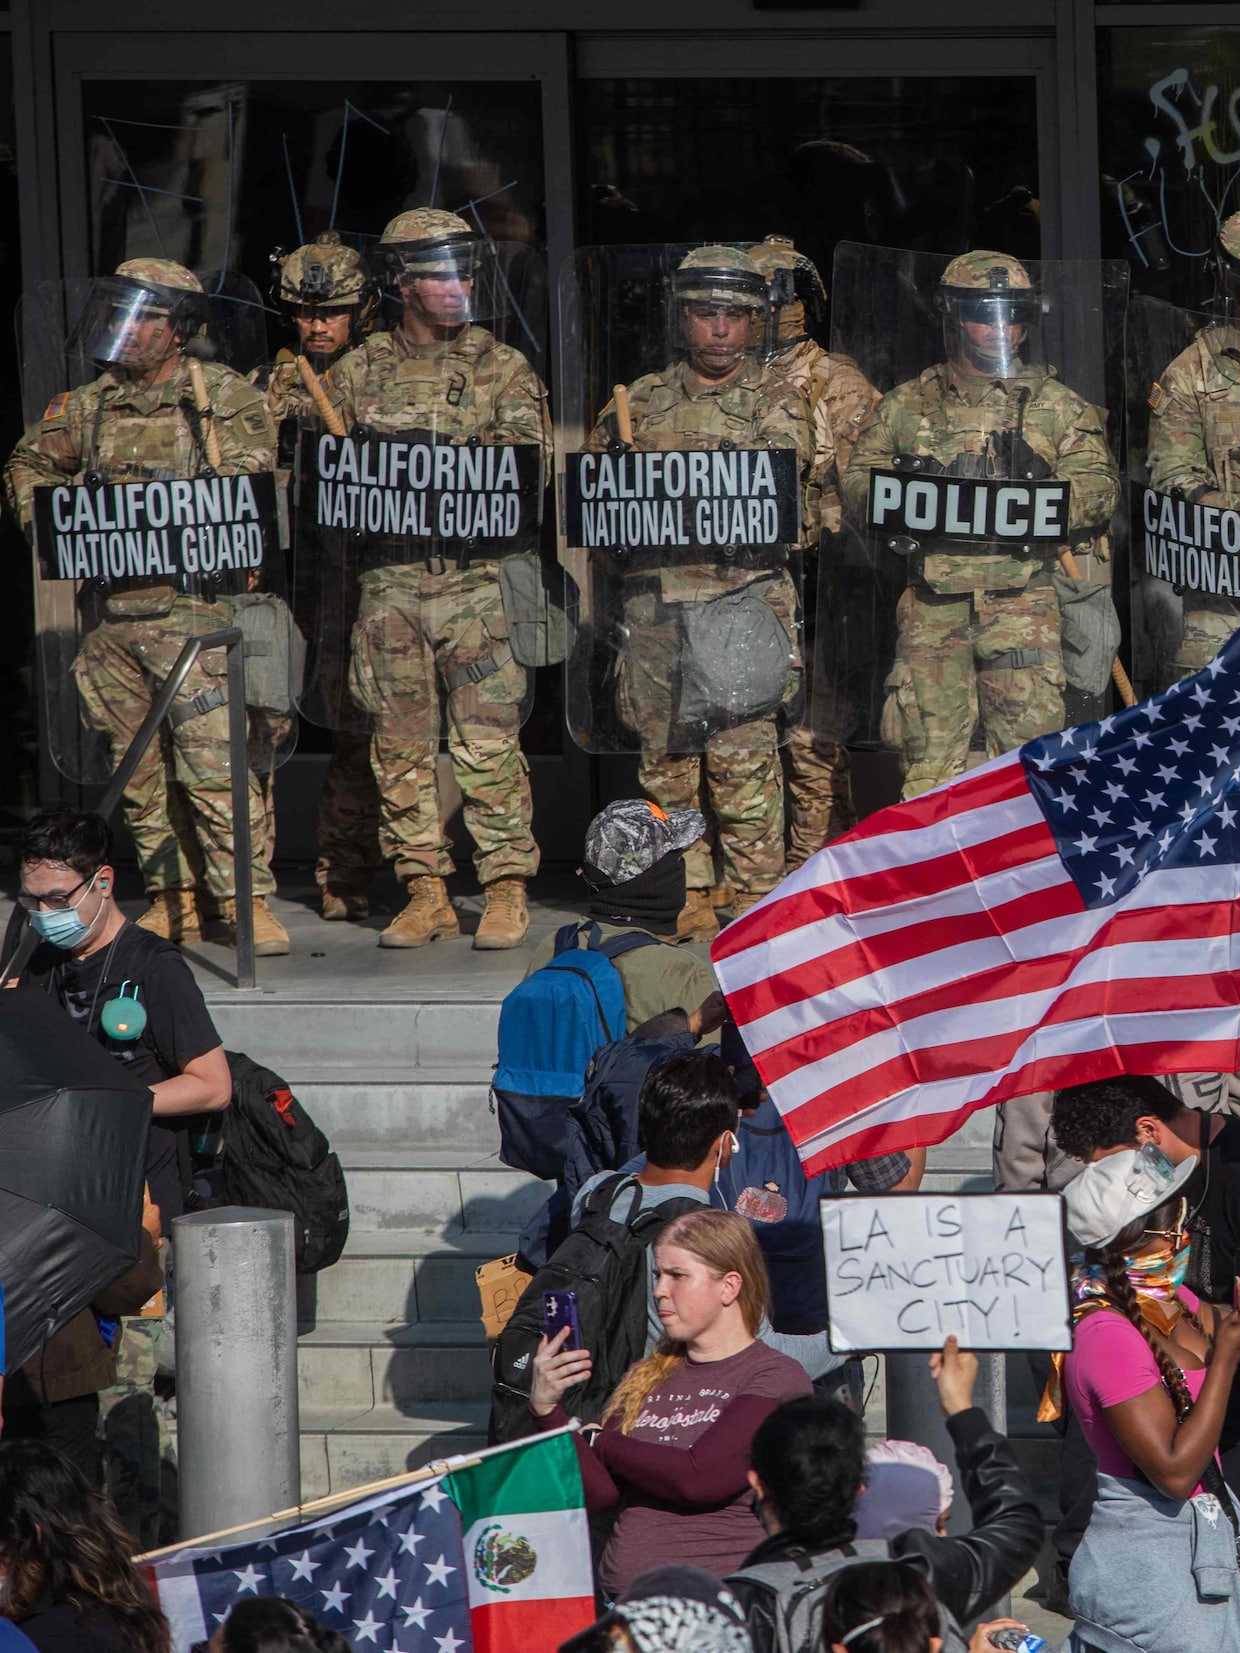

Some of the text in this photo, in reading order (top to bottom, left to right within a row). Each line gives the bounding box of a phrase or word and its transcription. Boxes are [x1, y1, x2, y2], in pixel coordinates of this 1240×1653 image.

[318, 434, 520, 491] CALIFORNIA
[579, 450, 778, 500] CALIFORNIA
[52, 475, 260, 533] CALIFORNIA
[317, 480, 521, 538] NATIONAL GUARD
[581, 498, 779, 548] NATIONAL GUARD
[872, 475, 1064, 537] POLICE
[56, 521, 264, 579] NATIONAL GUARD
[838, 1204, 1028, 1252] LA IS A
[834, 1252, 1054, 1297] SANCTUARY
[897, 1294, 1021, 1339] CITY!
